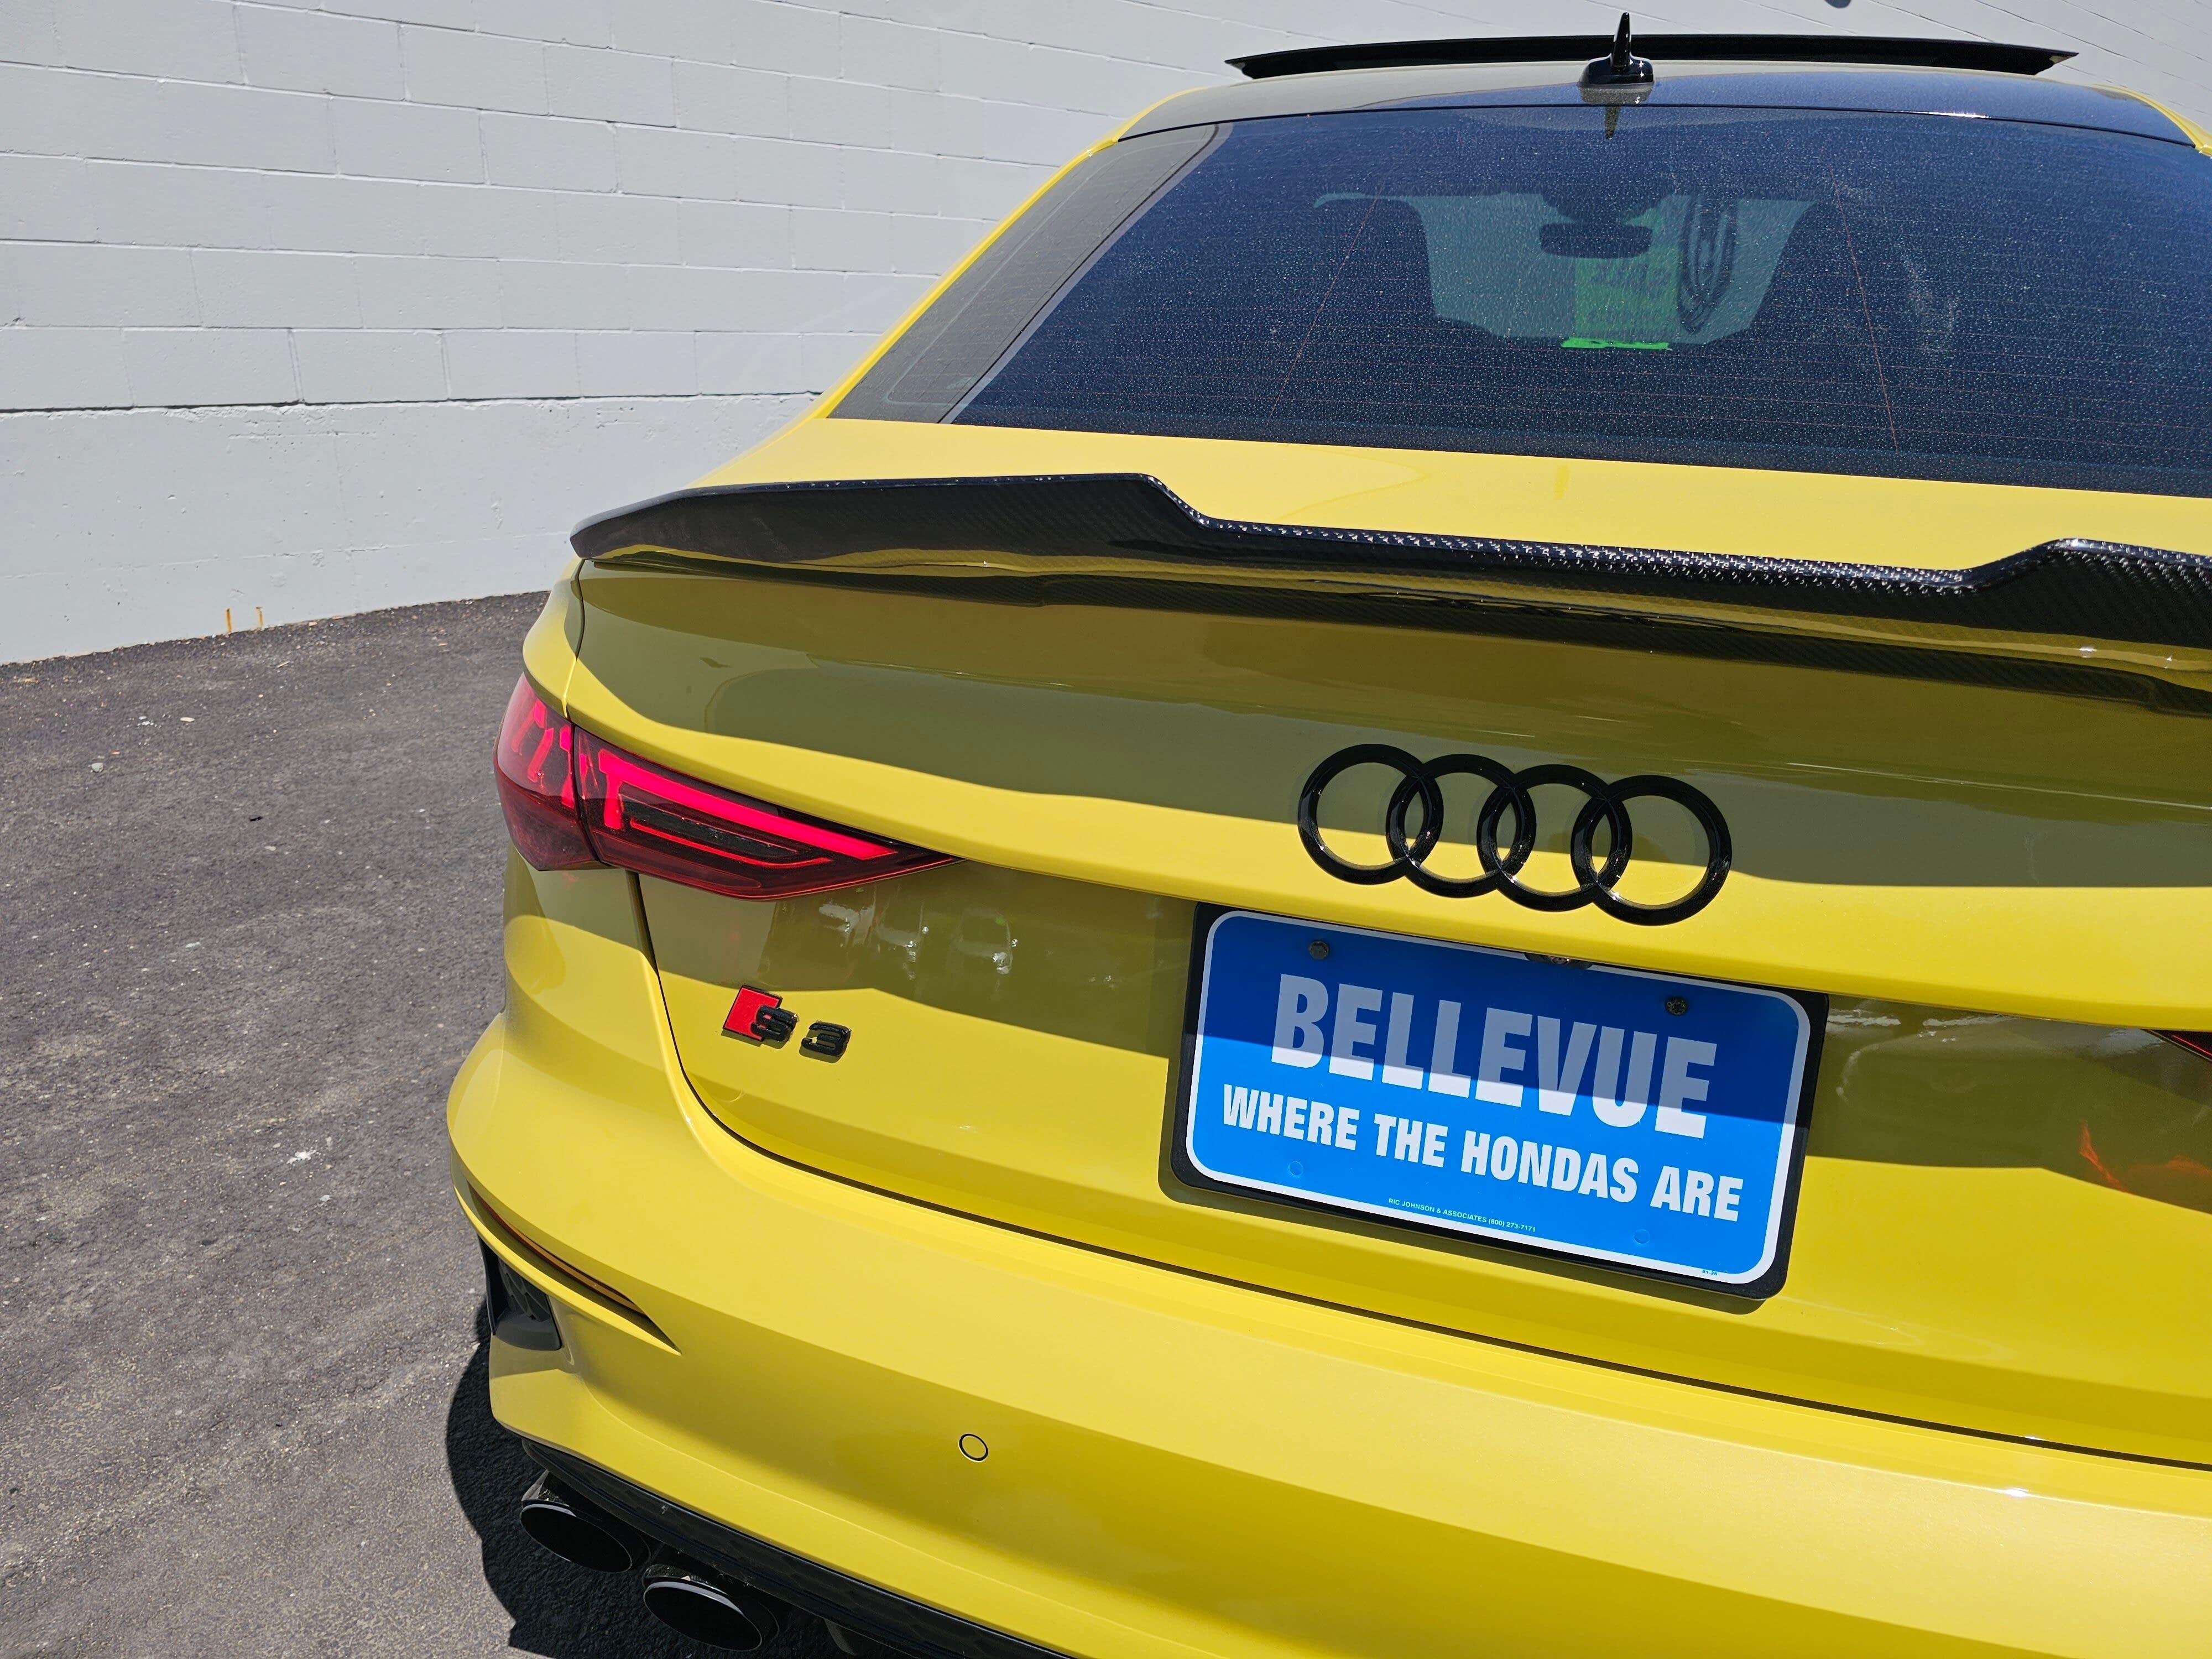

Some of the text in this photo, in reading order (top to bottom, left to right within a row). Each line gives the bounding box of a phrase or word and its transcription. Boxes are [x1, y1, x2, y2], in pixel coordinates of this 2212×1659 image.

[750, 1004, 852, 1056] S3
[1271, 974, 1717, 1139] BELLEVUE
[1223, 1084, 1744, 1222] WHERE THE HONDAS ARE
[1401, 1201, 1435, 1213] JOHNSON
[1443, 1209, 1487, 1223] ASSOCIATES
[1488, 1218, 1505, 1227] (800)
[1506, 1222, 1536, 1233] 273-7171
